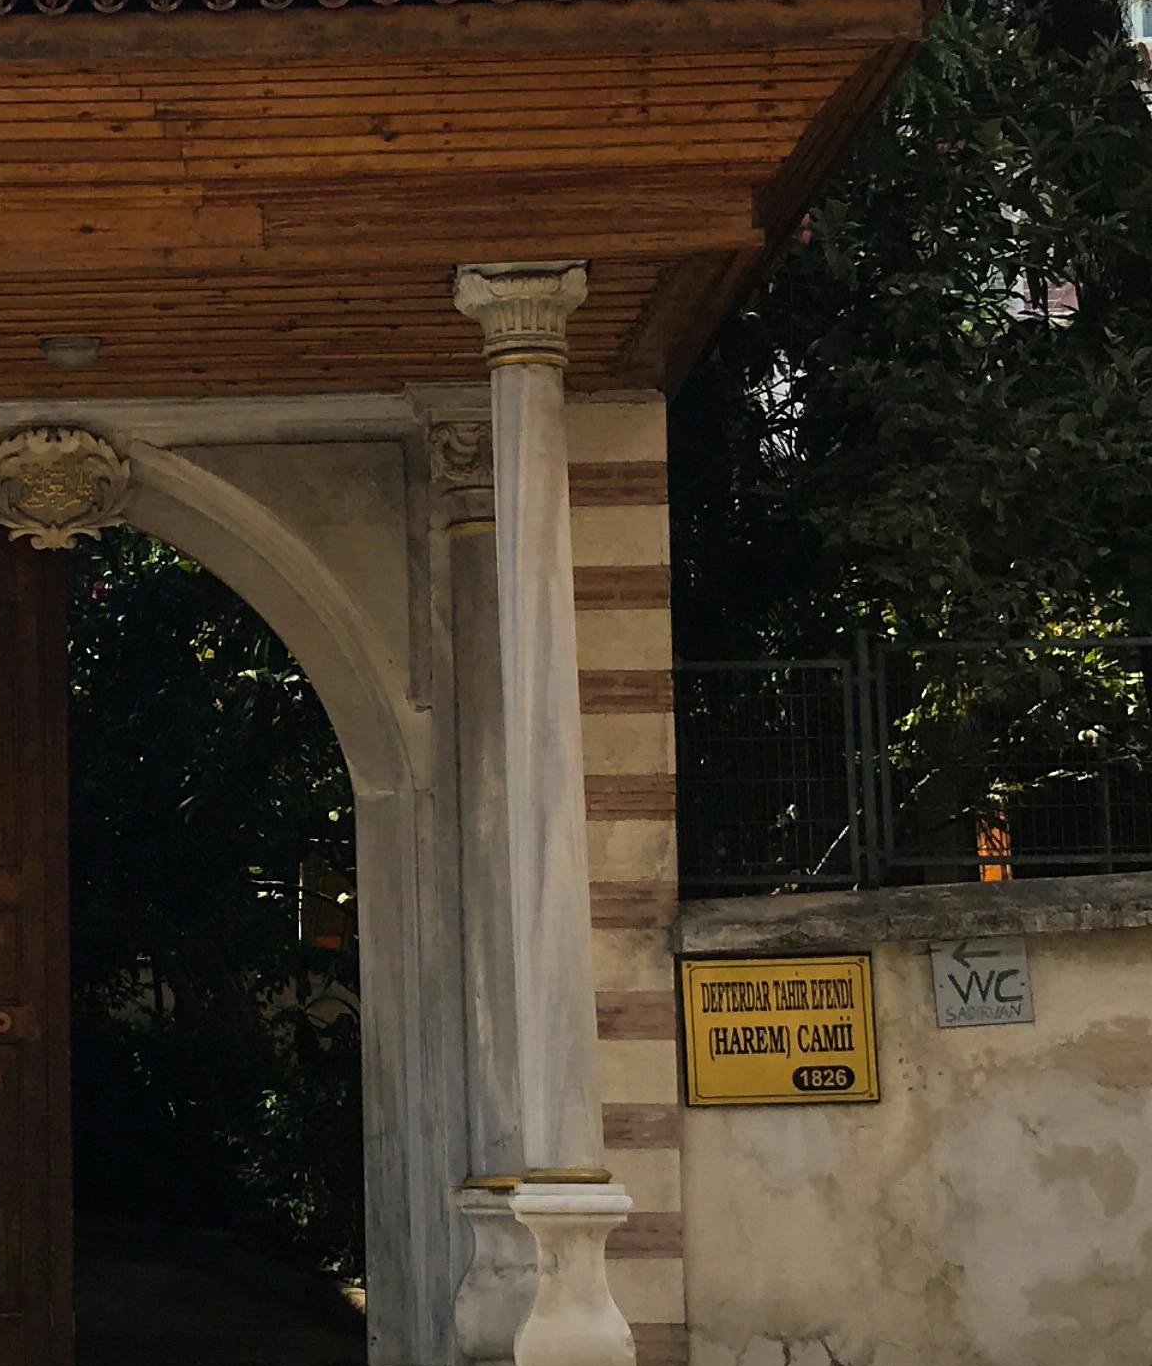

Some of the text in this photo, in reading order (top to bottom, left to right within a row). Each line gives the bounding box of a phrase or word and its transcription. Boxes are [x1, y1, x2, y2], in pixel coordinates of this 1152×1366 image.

[701, 970, 855, 1013] DEFTERDAR TAHİR EFENDİ
[947, 969, 1024, 1004] WC
[709, 1016, 855, 1061] (HAREM) CAMİİ
[799, 1069, 847, 1086] 1826
